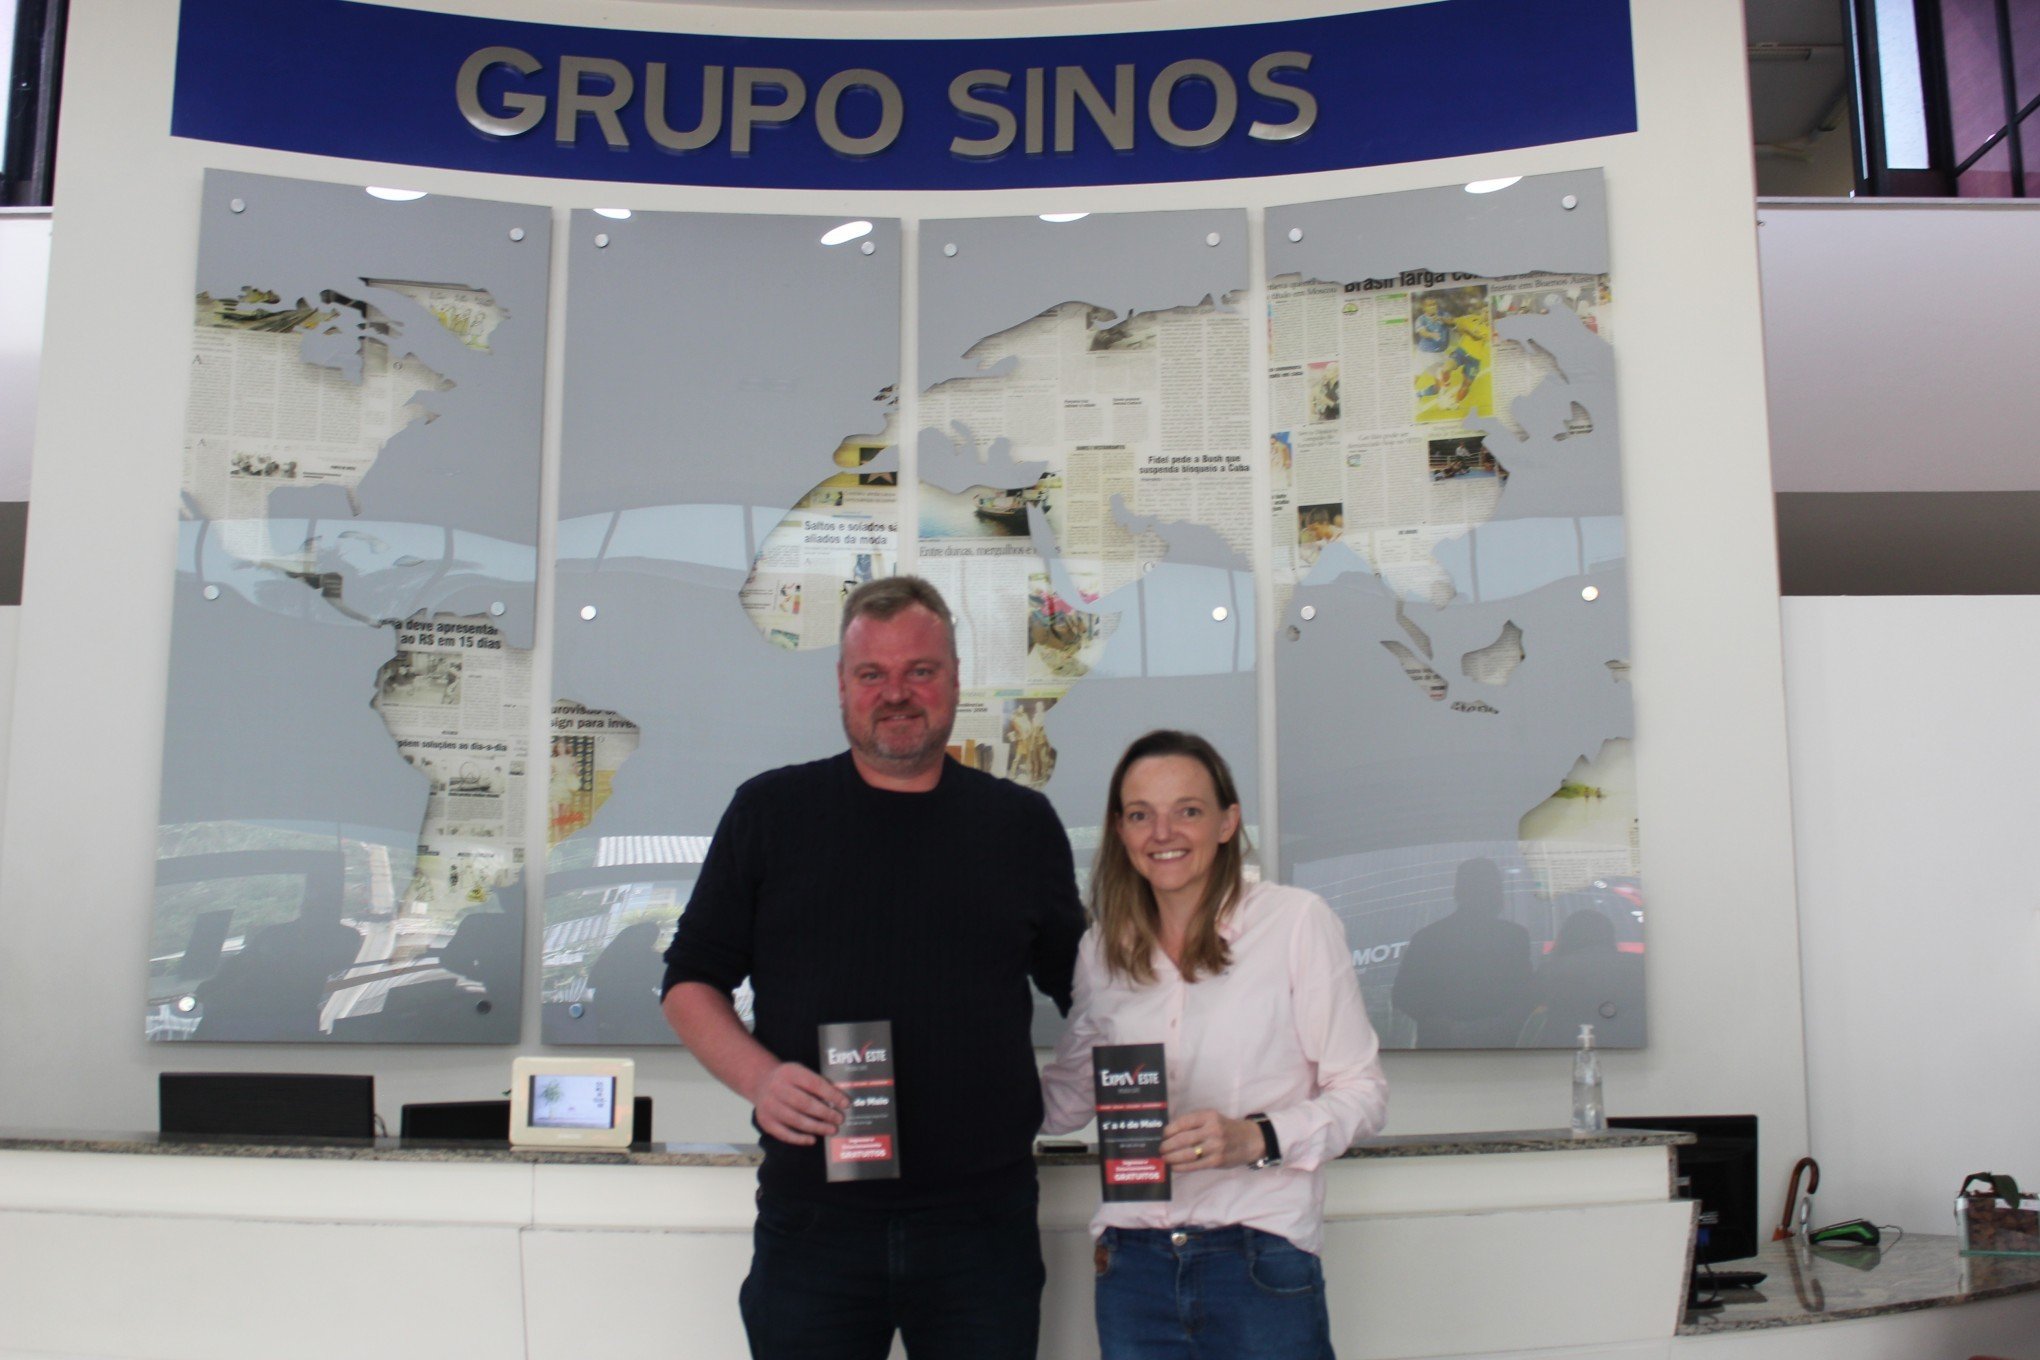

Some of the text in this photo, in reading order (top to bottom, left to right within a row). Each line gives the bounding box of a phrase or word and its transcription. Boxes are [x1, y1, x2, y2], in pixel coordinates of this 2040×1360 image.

[455, 46, 1319, 157] GRUPO SINOS
[1400, 270, 1446, 288] larga
[1148, 455, 1169, 464] Fidel
[1171, 455, 1192, 465] pede
[1202, 454, 1223, 463] Bush
[1225, 455, 1241, 464] que
[1139, 465, 1179, 475] suspenda
[1181, 464, 1218, 474] bloqueio
[1228, 463, 1250, 472] Cuba
[804, 520, 836, 531] Saltos
[838, 523, 845, 531] e
[847, 522, 885, 532] solados
[804, 533, 887, 545] aliados da moda
[405, 618, 434, 632] deve
[400, 633, 501, 650] ao RS em 15 dias
[577, 718, 605, 730] para
[422, 740, 458, 751] soluções
[852, 1095, 890, 1107] de Maio
[1126, 1119, 1140, 1130] de
[1140, 1118, 1164, 1129] Maio
